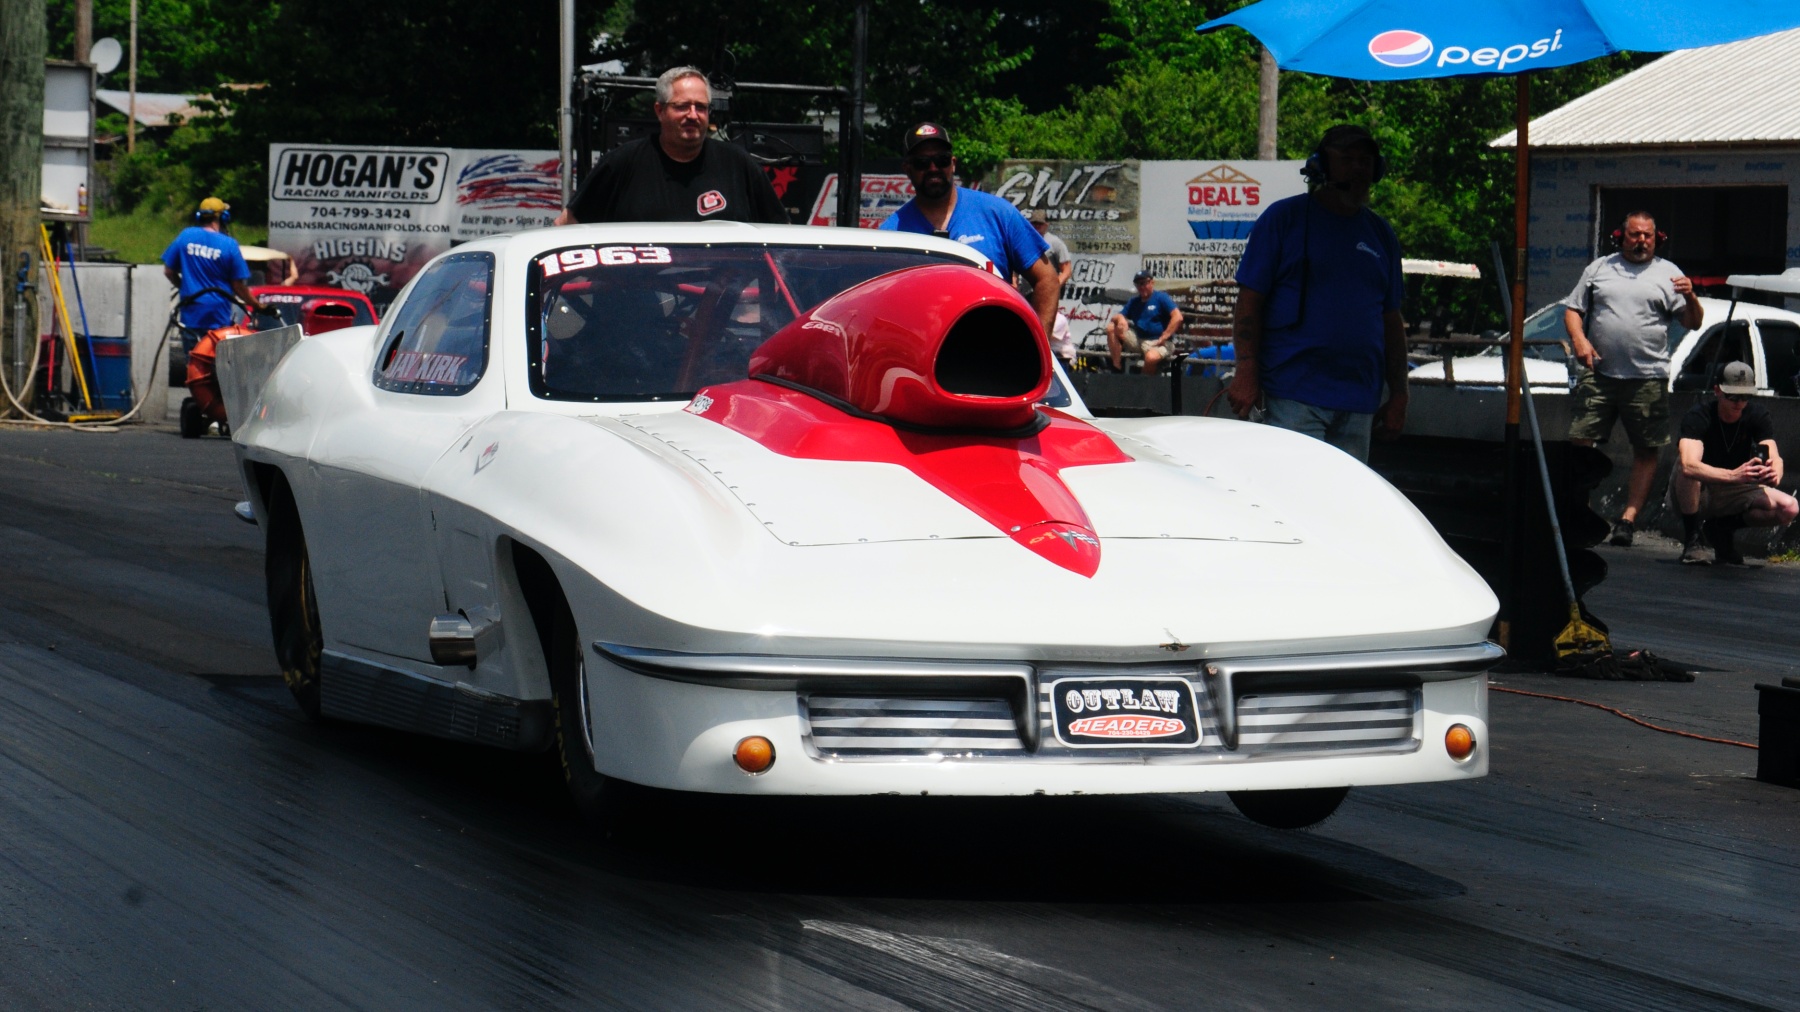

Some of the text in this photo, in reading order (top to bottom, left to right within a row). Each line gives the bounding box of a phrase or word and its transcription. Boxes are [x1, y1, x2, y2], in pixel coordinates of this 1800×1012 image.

[1436, 28, 1563, 70] pepsi
[283, 153, 439, 190] HOGAN'S
[283, 188, 429, 200] RACING MANIFOLDS
[995, 163, 1124, 207] GWT
[1187, 186, 1261, 207] DEAL'S
[310, 206, 412, 219] 704-799-3424
[1020, 208, 1121, 221] SRVICES
[270, 220, 450, 233] HOGANSRACINGMANIFOLDS.COM
[186, 242, 222, 260] STAFF
[313, 238, 408, 262] HIGGINS
[537, 246, 673, 278] 1963
[1172, 259, 1205, 281] KELLER
[415, 352, 468, 384] KIRK
[1066, 688, 1181, 714] OUTLAW
[1074, 719, 1180, 732] HEADERS
